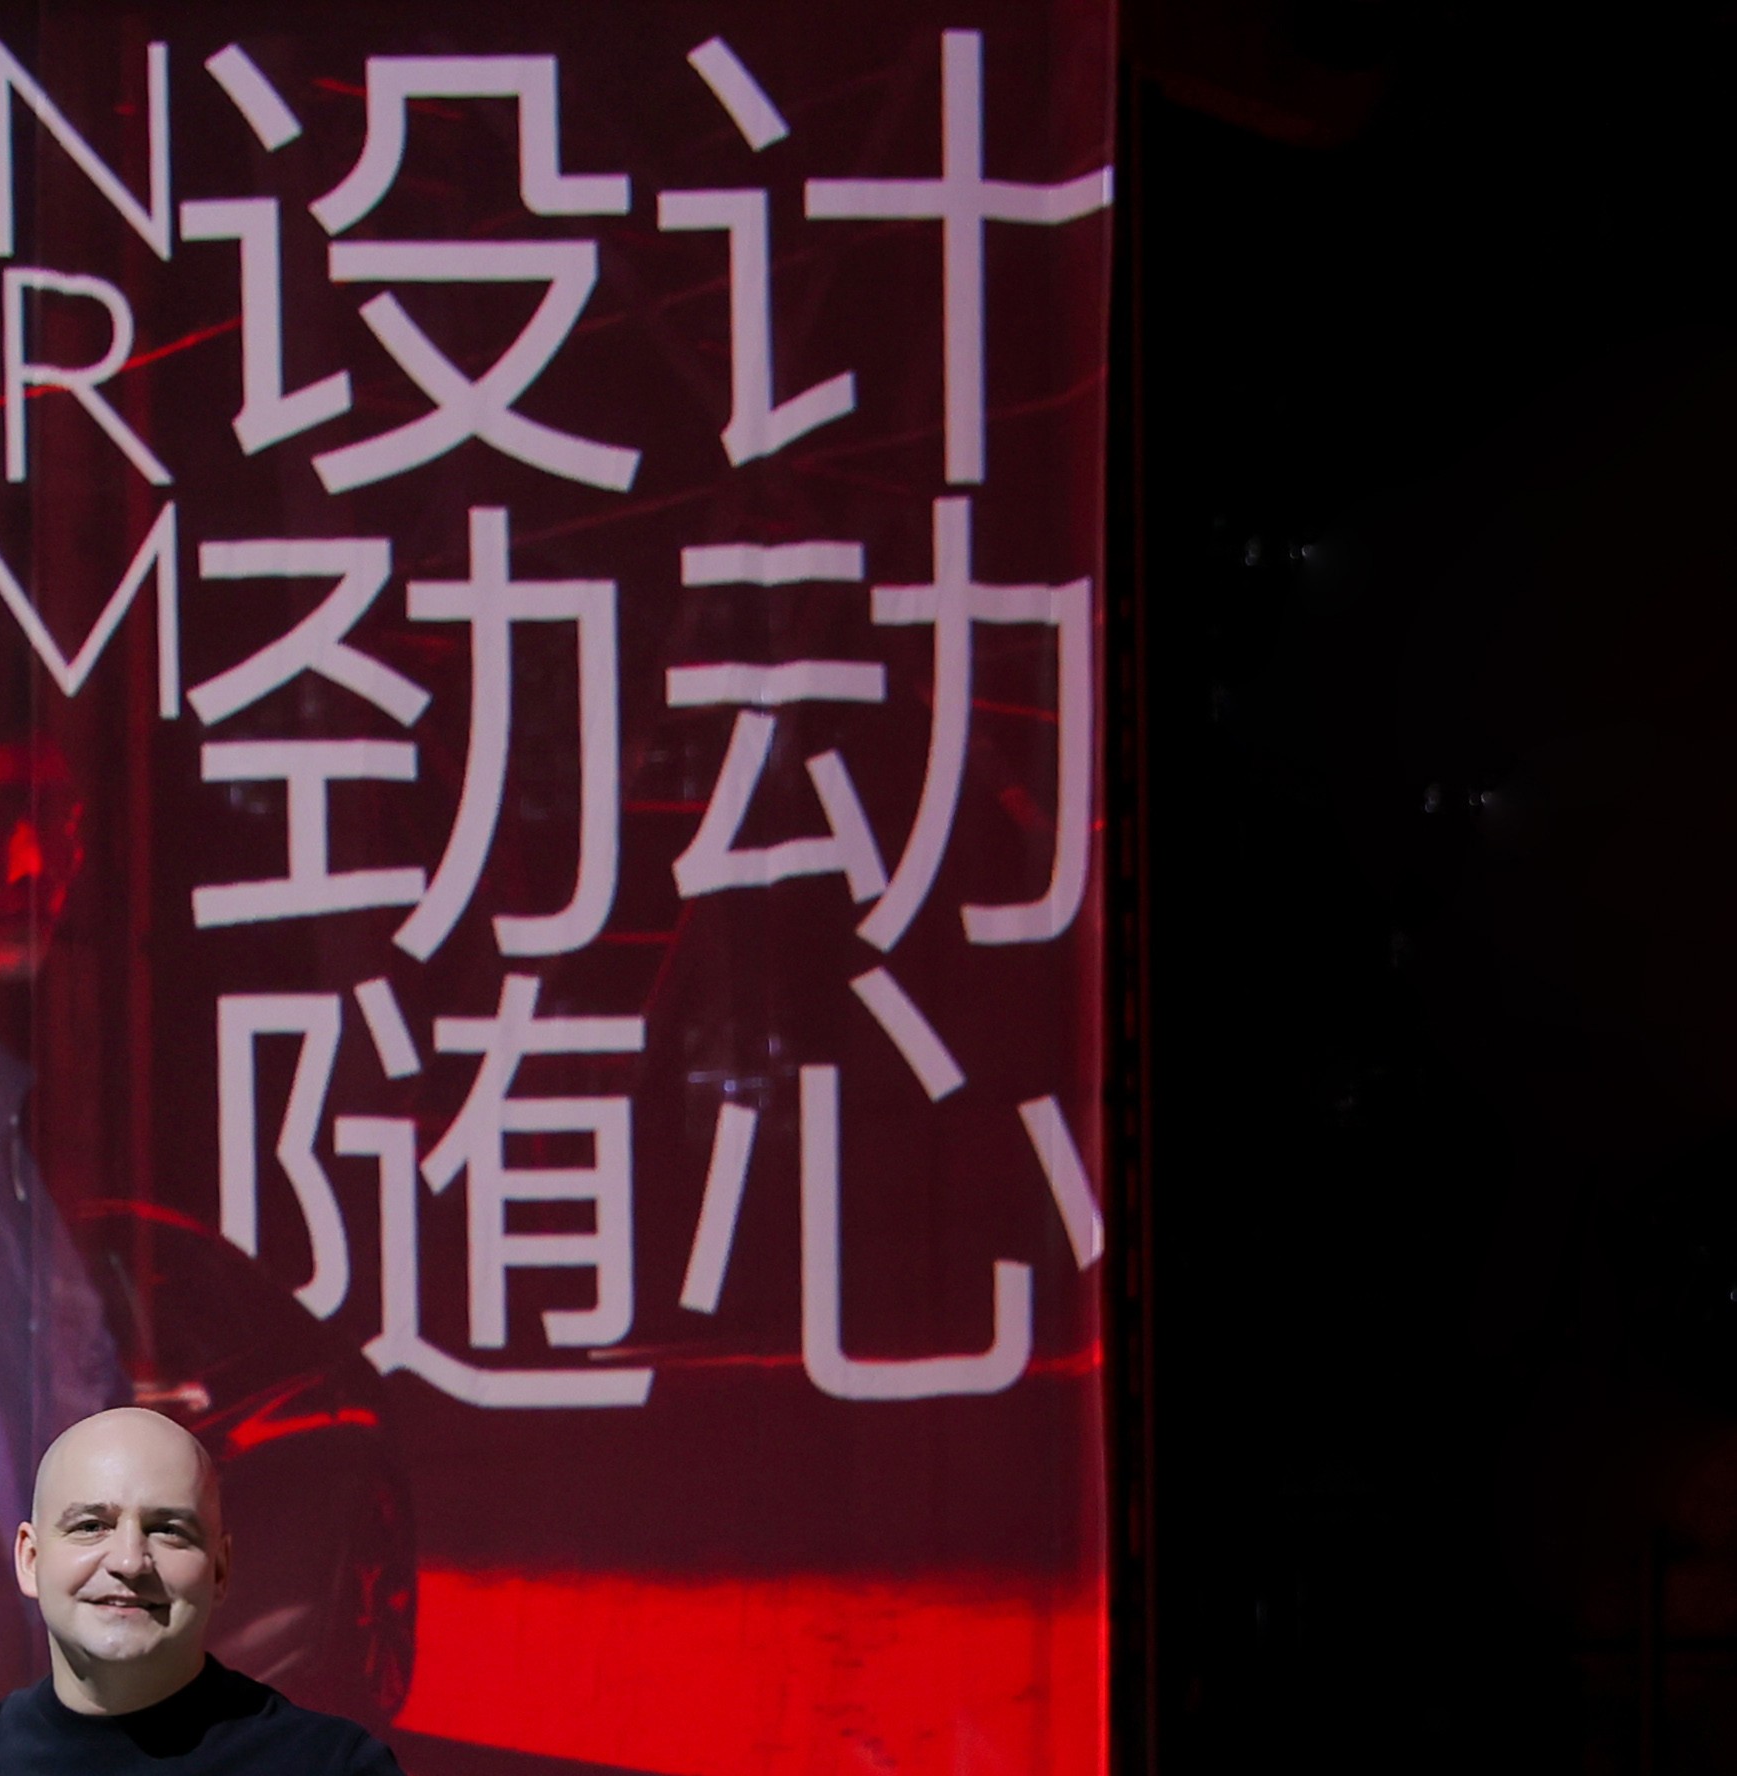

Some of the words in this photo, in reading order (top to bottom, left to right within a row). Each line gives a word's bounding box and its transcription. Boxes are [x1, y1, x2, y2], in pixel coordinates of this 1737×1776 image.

[179, 30, 1114, 493] 设计
[186, 497, 1093, 962] 劲动
[216, 969, 1105, 1408] 随心
